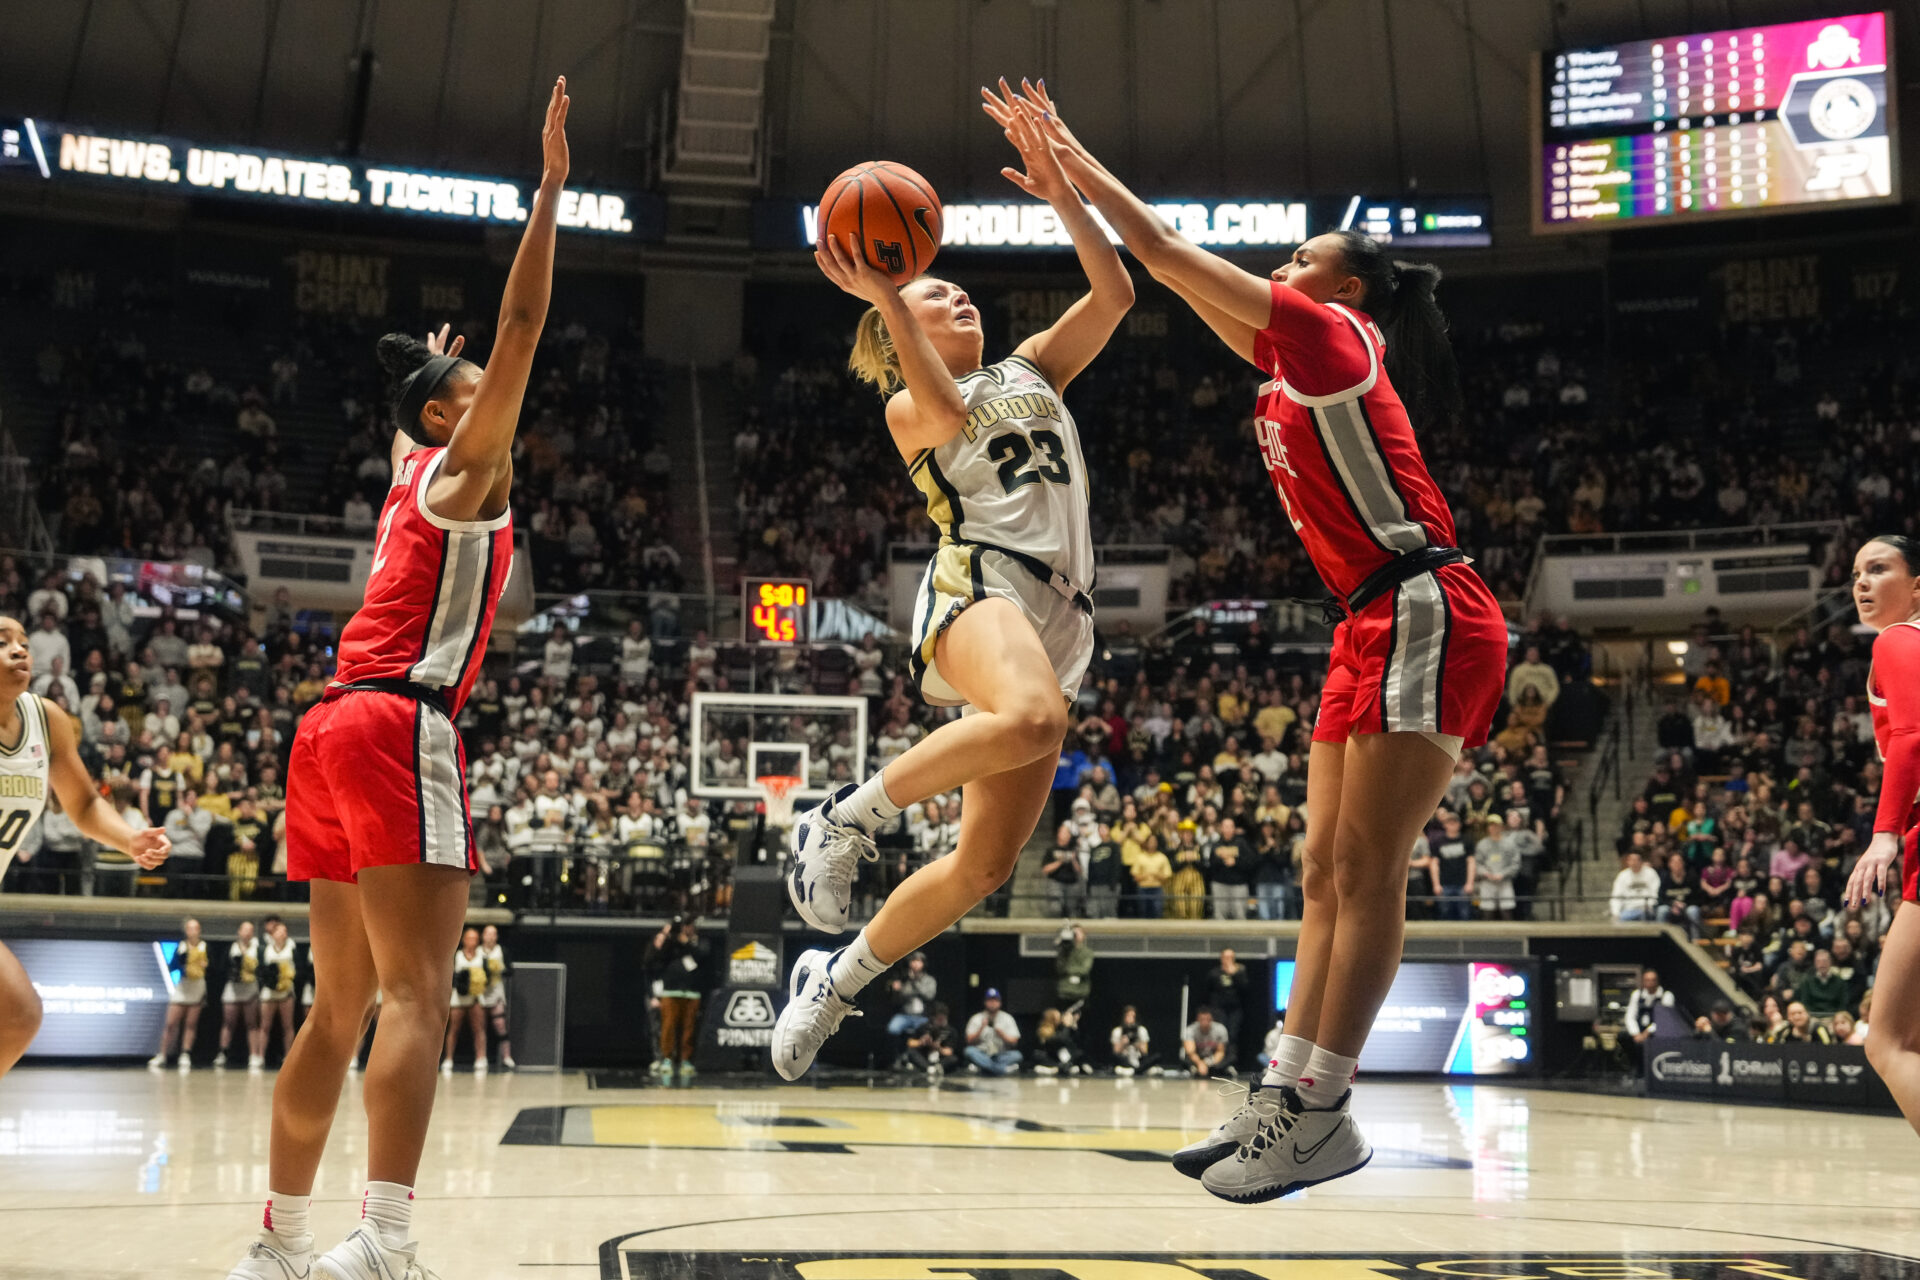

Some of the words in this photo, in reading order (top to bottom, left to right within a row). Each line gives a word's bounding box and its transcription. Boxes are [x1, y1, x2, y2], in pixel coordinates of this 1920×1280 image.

[59, 133, 180, 183] NEWS.
[186, 148, 360, 203] UPDATES.
[366, 169, 527, 221] TICKETS.
[533, 189, 633, 232] EAR.
[961, 392, 1062, 444] PURDUE
[987, 428, 1072, 497] 23
[0, 774, 44, 800] RDUE
[0, 809, 31, 849] 0
